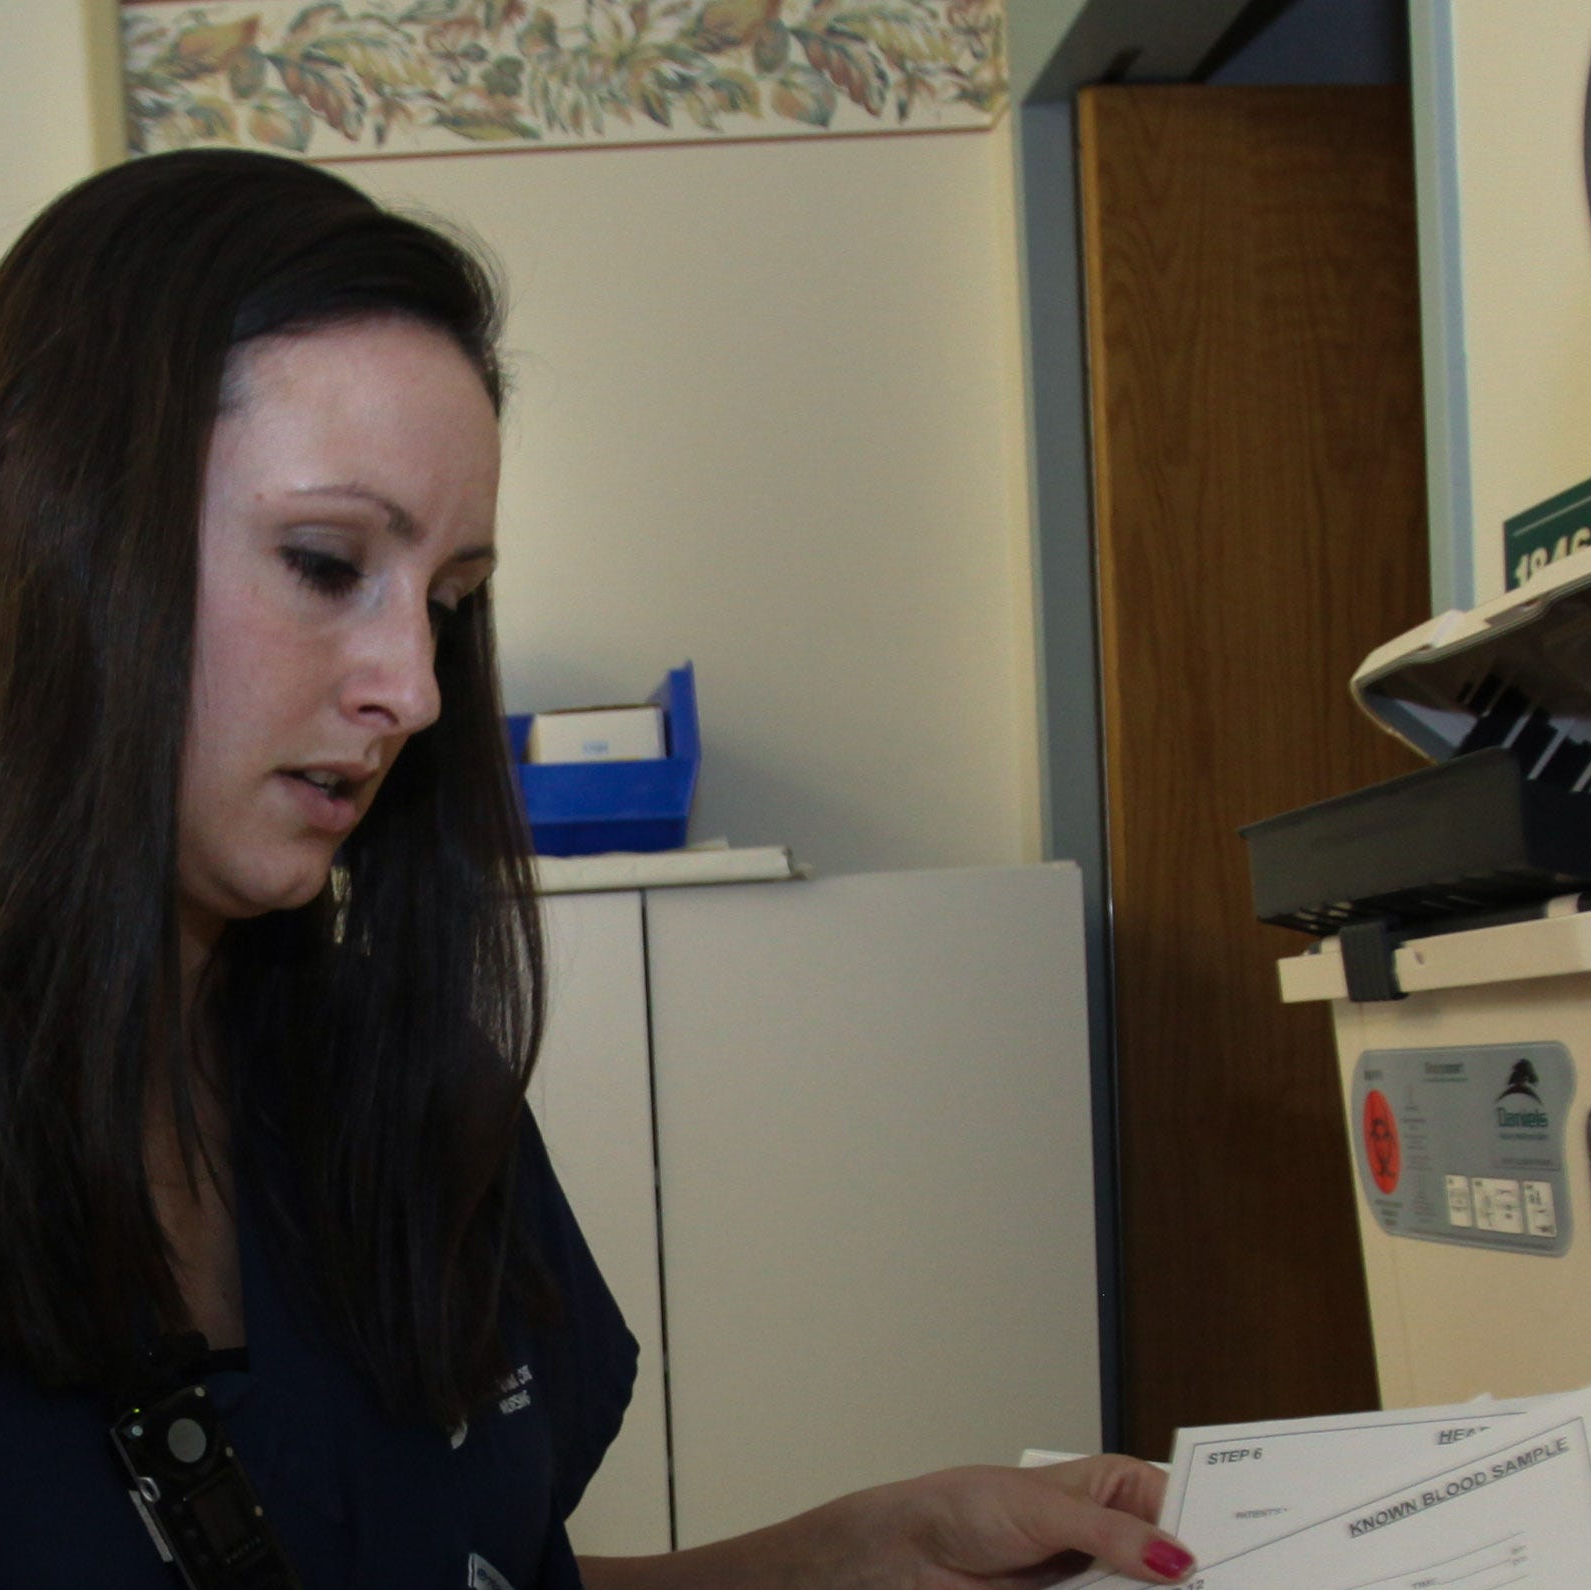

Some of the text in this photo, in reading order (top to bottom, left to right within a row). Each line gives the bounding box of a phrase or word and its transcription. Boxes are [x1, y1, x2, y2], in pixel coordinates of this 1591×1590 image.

[1496, 1106, 1549, 1128] Daniels
[1207, 1447, 1264, 1466] STEP 6
[1348, 1436, 1571, 1538] KNOWN BLOOD SAMPLE
